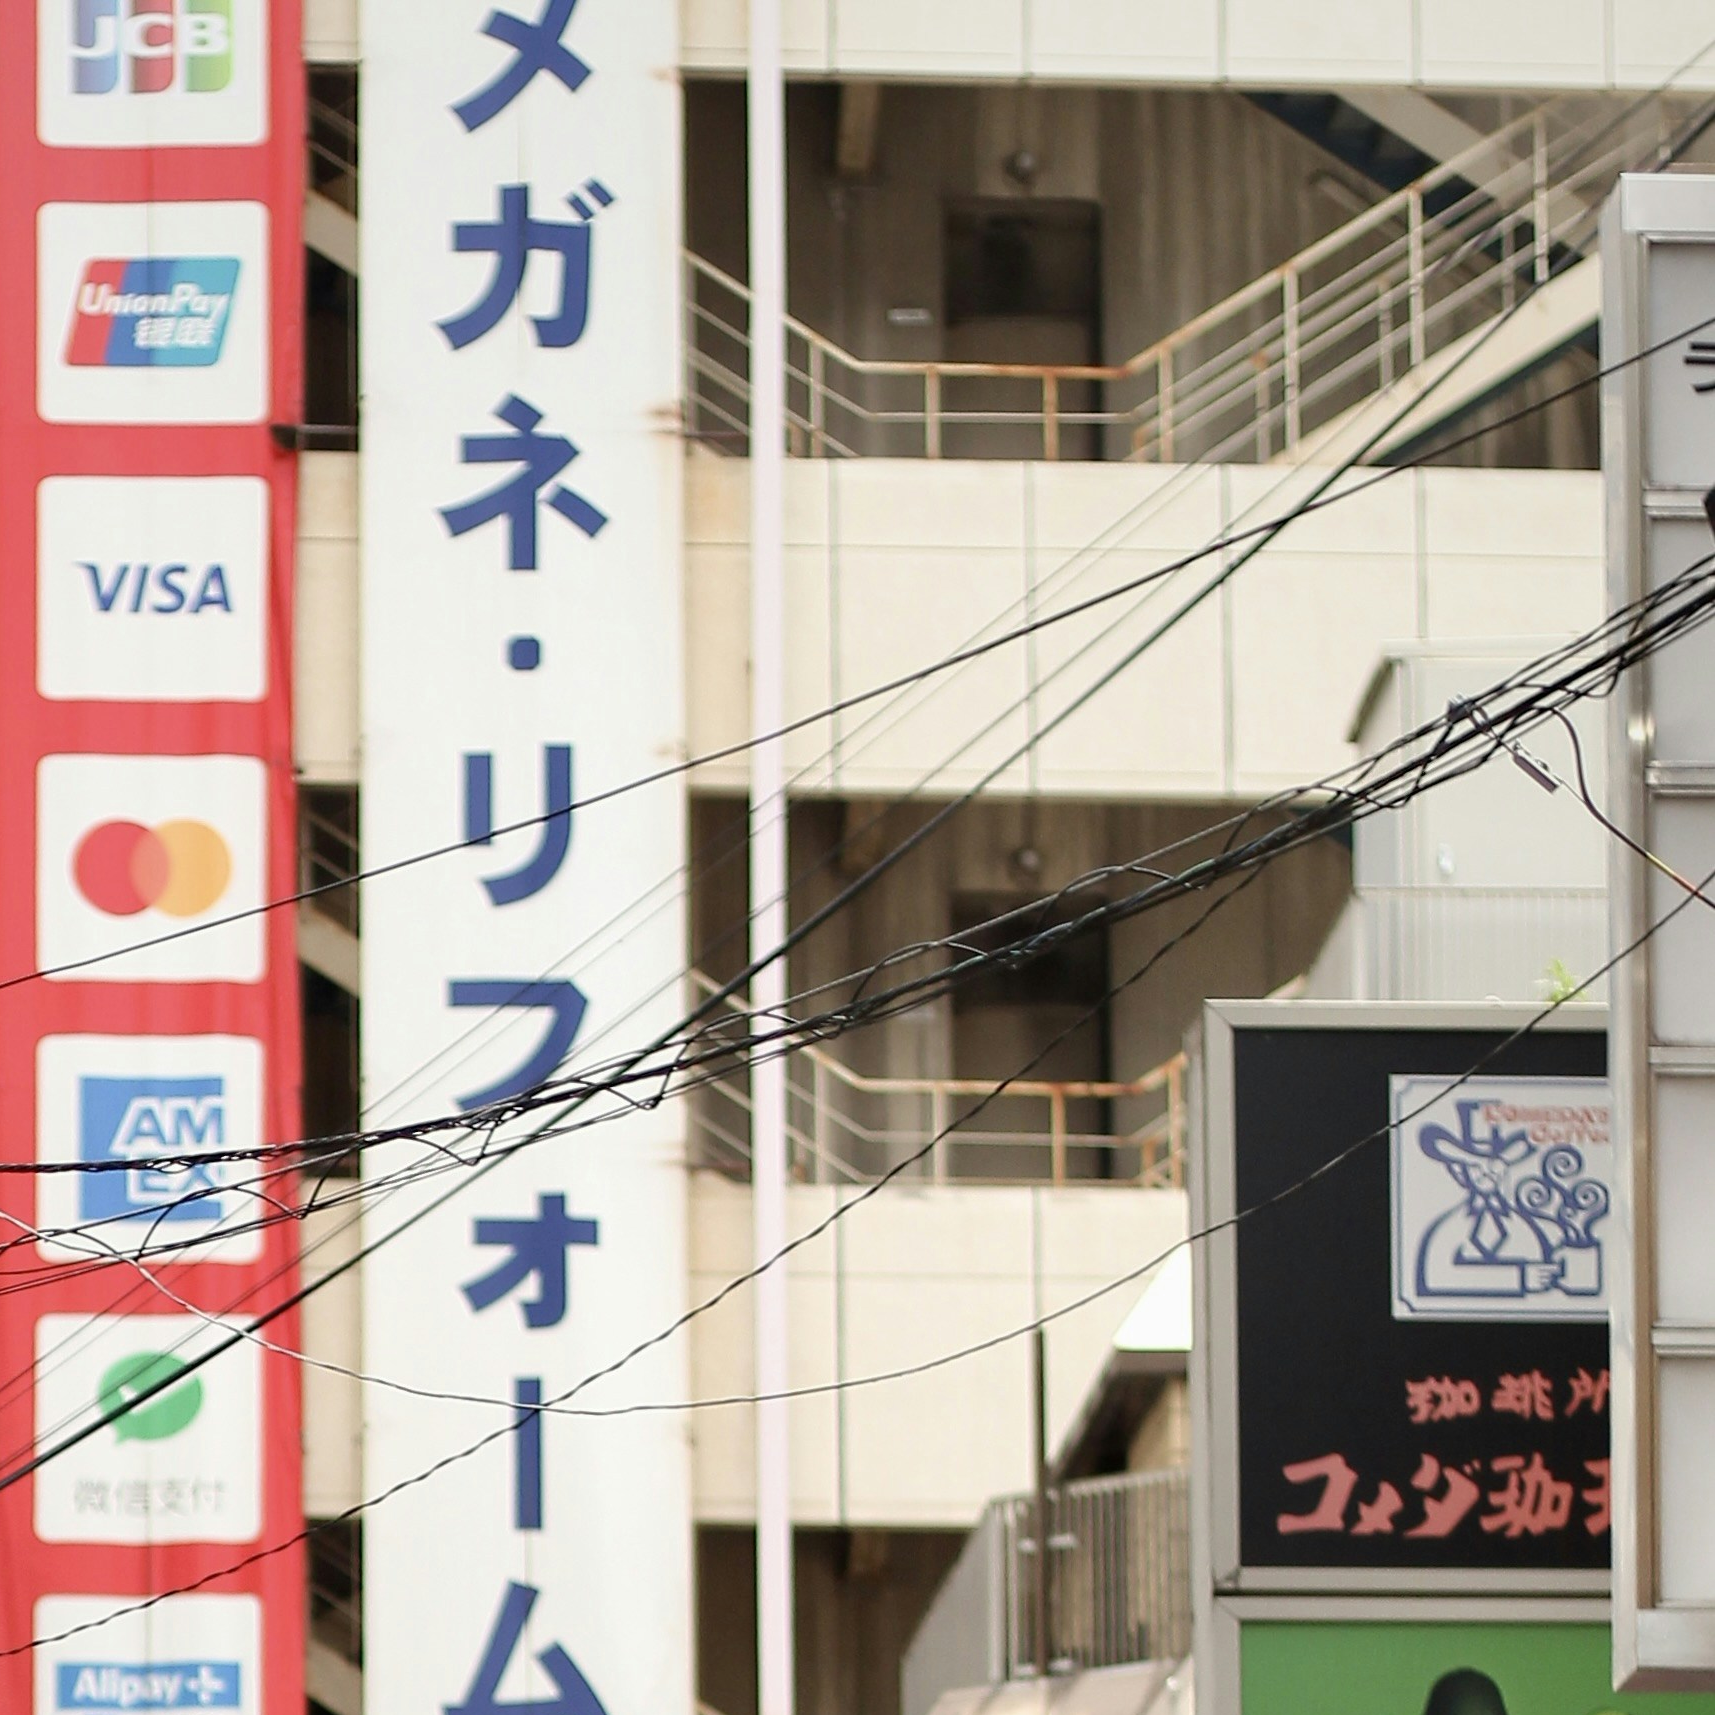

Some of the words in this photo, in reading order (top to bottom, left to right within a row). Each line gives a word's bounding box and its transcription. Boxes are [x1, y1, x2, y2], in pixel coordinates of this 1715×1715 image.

[70, 14, 231, 58] JCB
[76, 281, 230, 320] UnionPay
[72, 561, 233, 613] VISA
